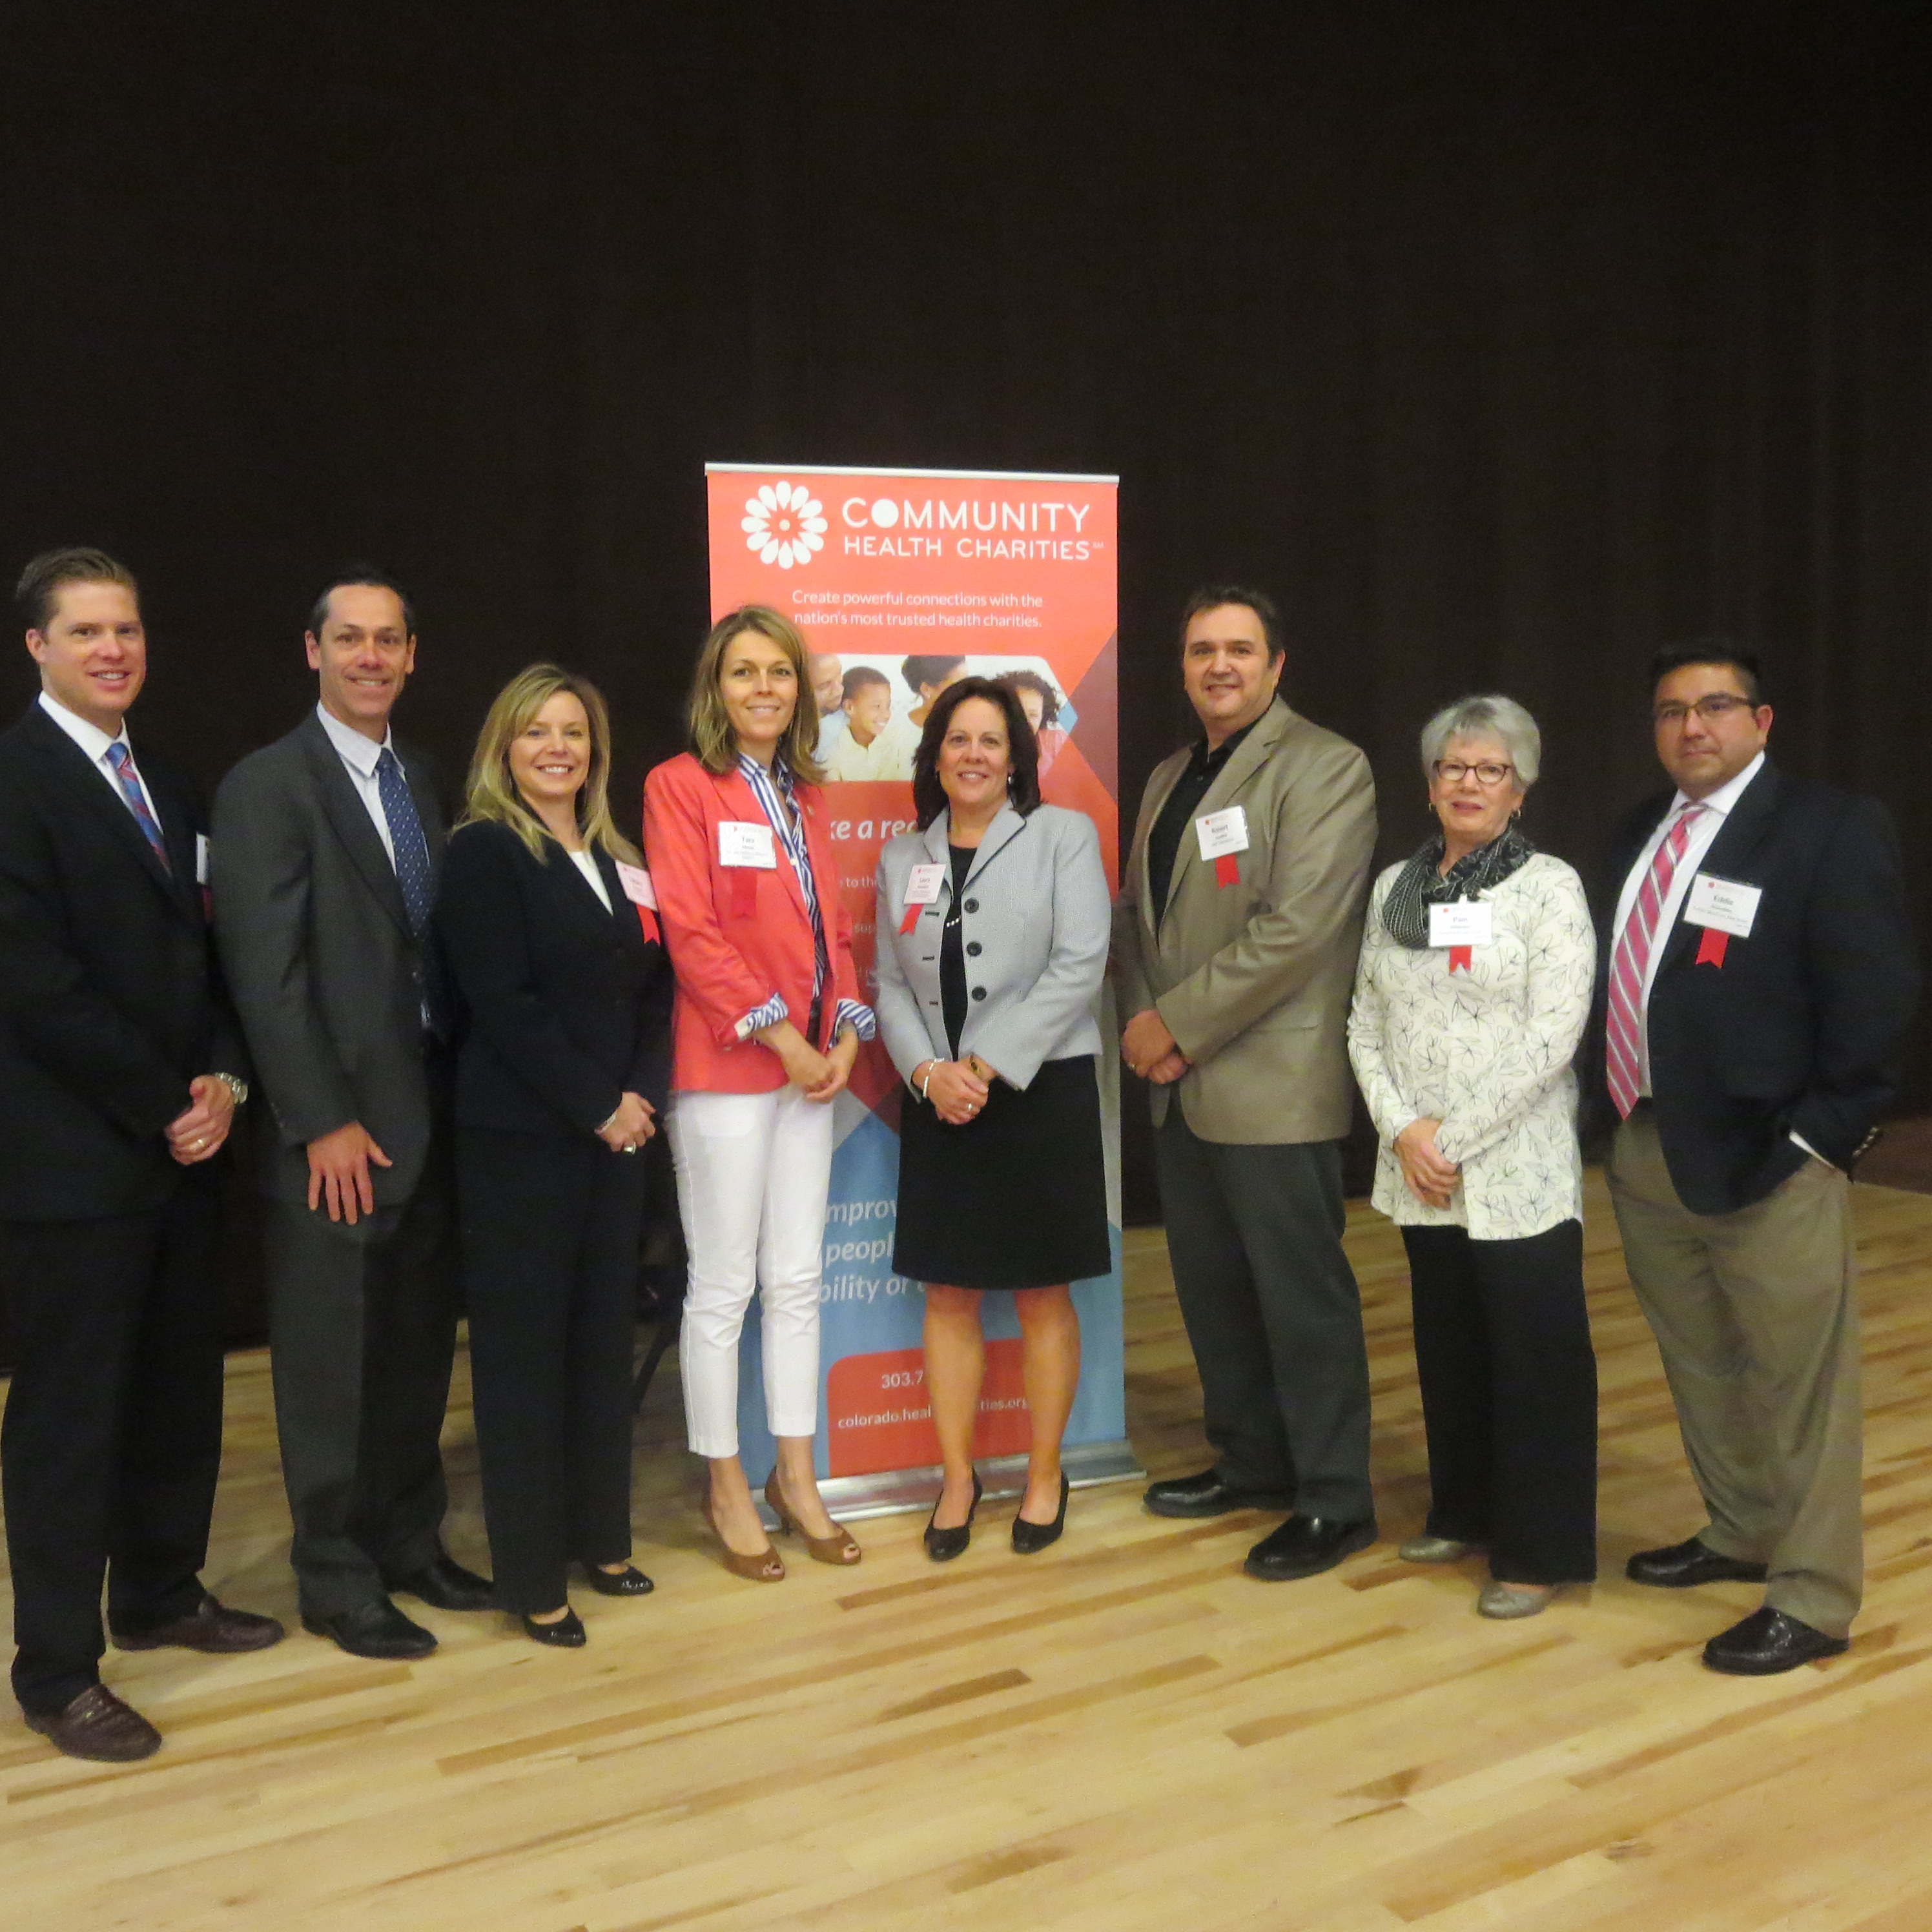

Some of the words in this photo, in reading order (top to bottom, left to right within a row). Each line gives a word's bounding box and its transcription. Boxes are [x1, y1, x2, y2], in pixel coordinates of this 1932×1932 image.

[842, 497, 1091, 533] COMMUNITY
[844, 535, 942, 557] HEALTH
[956, 538, 1090, 560] CHARITIES
[792, 589, 840, 604] Create
[843, 591, 903, 607] powerful
[906, 591, 987, 608] connections
[989, 593, 1018, 608] with
[1021, 593, 1043, 608] the
[794, 610, 847, 625] nation's
[850, 613, 884, 626] most
[887, 612, 936, 627] trusted
[939, 612, 981, 627] health
[983, 613, 1042, 628] charities.
[857, 819, 874, 840] a
[846, 878, 859, 888] to
[825, 1231, 894, 1269] peopl
[881, 1370, 924, 1389] 303.7
